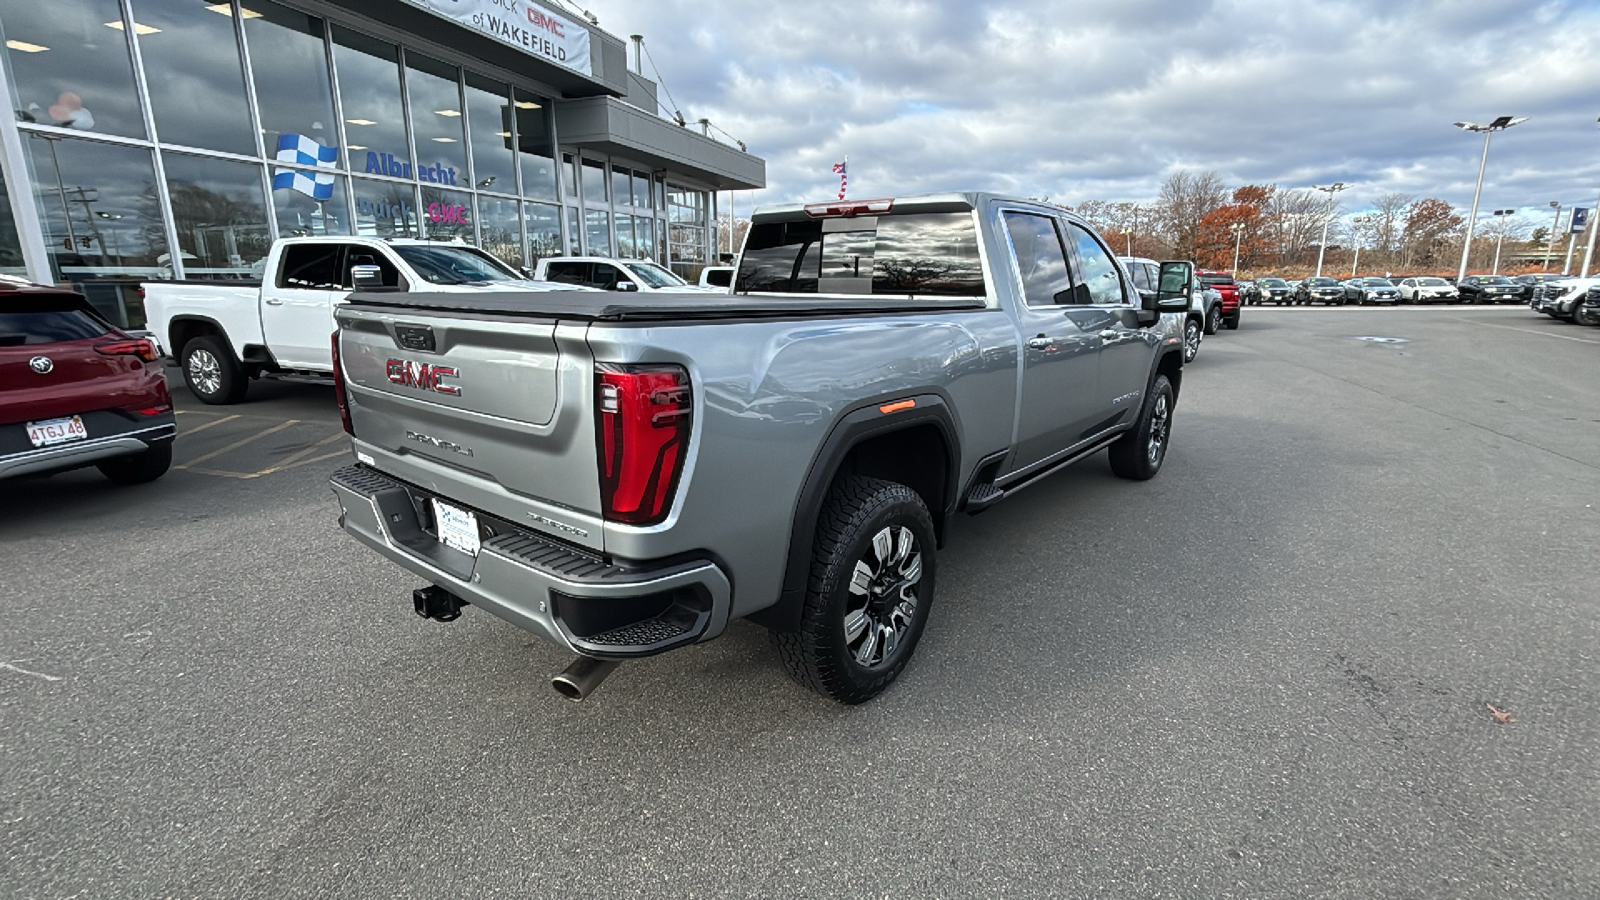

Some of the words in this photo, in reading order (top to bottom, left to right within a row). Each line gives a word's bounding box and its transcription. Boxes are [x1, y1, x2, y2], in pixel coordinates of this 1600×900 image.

[473, 12, 485, 28] of
[487, 13, 567, 62] WAKEFIELD
[527, 7, 566, 39] GMC
[366, 151, 457, 186] Albrecht
[358, 197, 411, 220] Buick
[428, 202, 468, 225] GMC
[386, 358, 462, 397] GMC
[31, 424, 66, 441] 4TGJ
[68, 421, 84, 435] 48
